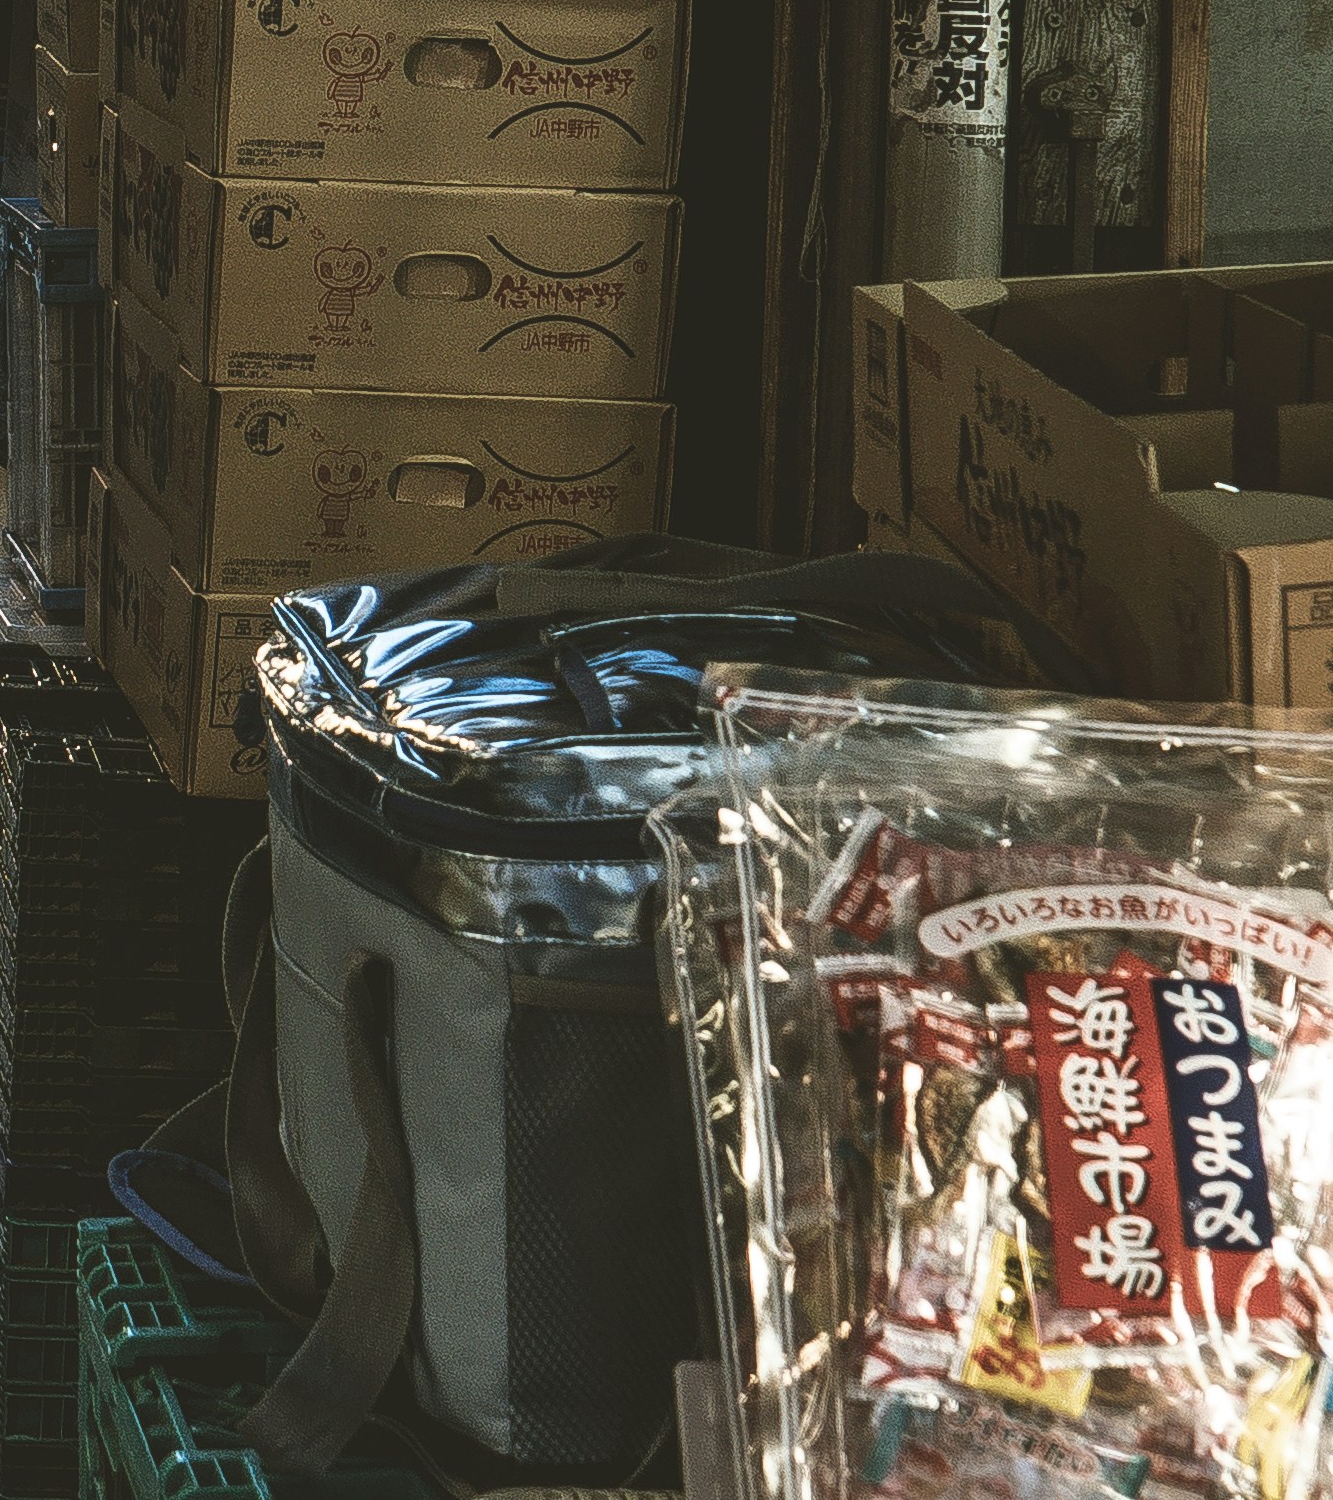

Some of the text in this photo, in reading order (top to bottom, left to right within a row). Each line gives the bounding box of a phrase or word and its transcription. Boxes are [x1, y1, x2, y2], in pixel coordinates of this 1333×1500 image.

[501, 60, 636, 102] 信州中野
[529, 119, 602, 140] JA中野市
[493, 274, 627, 315] 信州中野
[520, 331, 591, 354] JA中野市
[488, 478, 619, 515] 信州中野
[941, 893, 1312, 967] いろいろなお魚がいっぱい!
[1162, 983, 1262, 1247] おつまみ
[1045, 978, 1165, 1299] 海鮮市場
